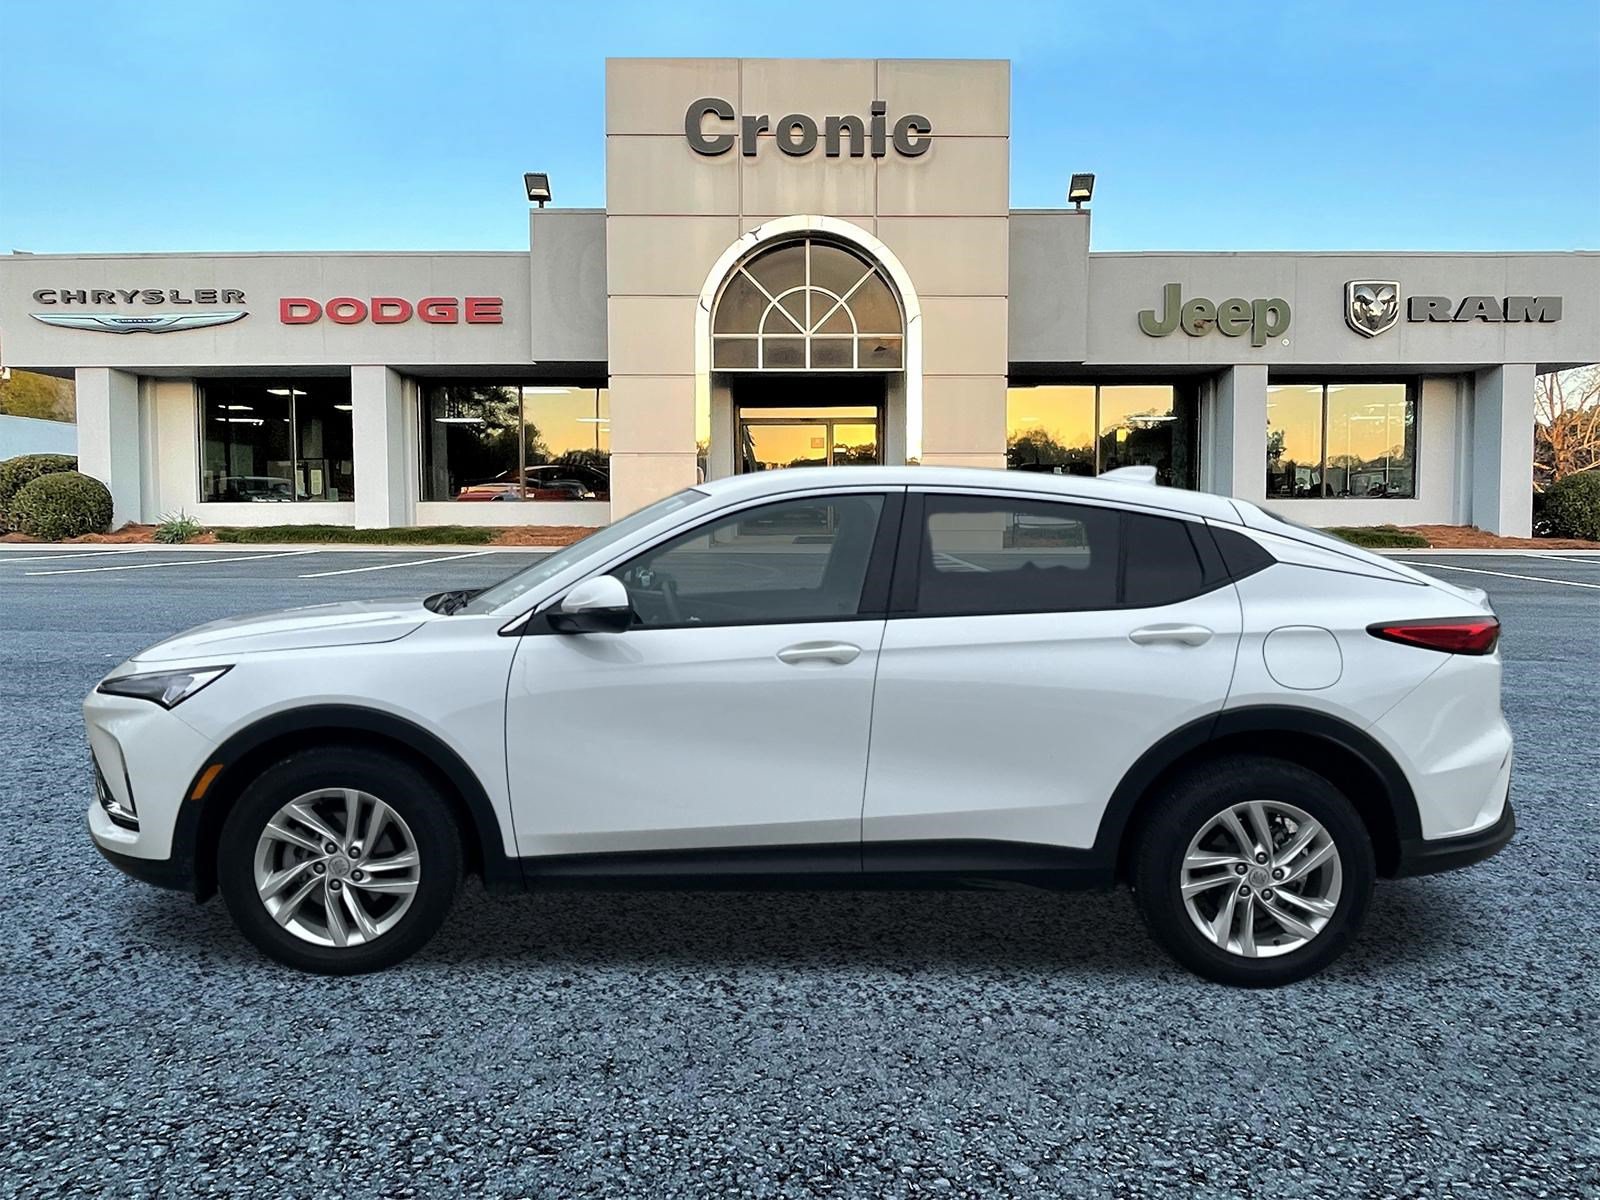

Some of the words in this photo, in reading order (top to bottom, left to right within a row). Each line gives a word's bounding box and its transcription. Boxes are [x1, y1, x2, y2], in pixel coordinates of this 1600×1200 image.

[685, 97, 932, 157] Cronic
[32, 288, 246, 305] CHRYSLER
[1407, 296, 1563, 323] RAM
[280, 297, 503, 324] DODGE
[1138, 283, 1291, 347] Jeep
